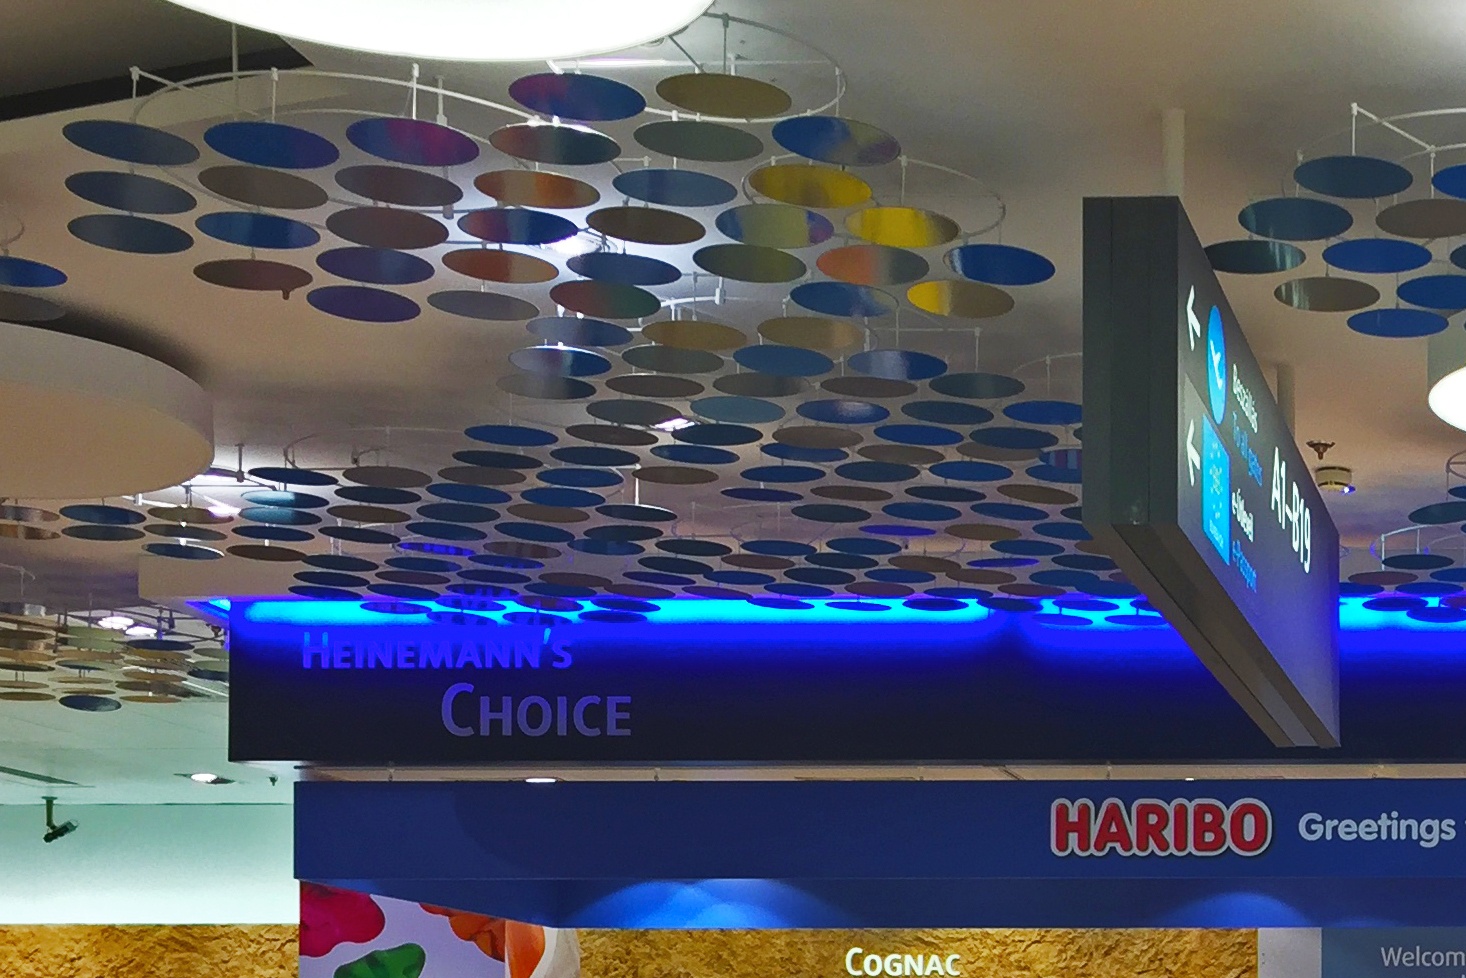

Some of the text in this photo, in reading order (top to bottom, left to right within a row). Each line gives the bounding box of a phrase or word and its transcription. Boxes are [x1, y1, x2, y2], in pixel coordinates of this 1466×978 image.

[1271, 446, 1311, 574] A1-B19
[441, 682, 631, 737] CHOICE
[1050, 797, 1274, 858] HARIBO
[1299, 811, 1457, 848] Greetings
[845, 946, 961, 978] COGNAC
